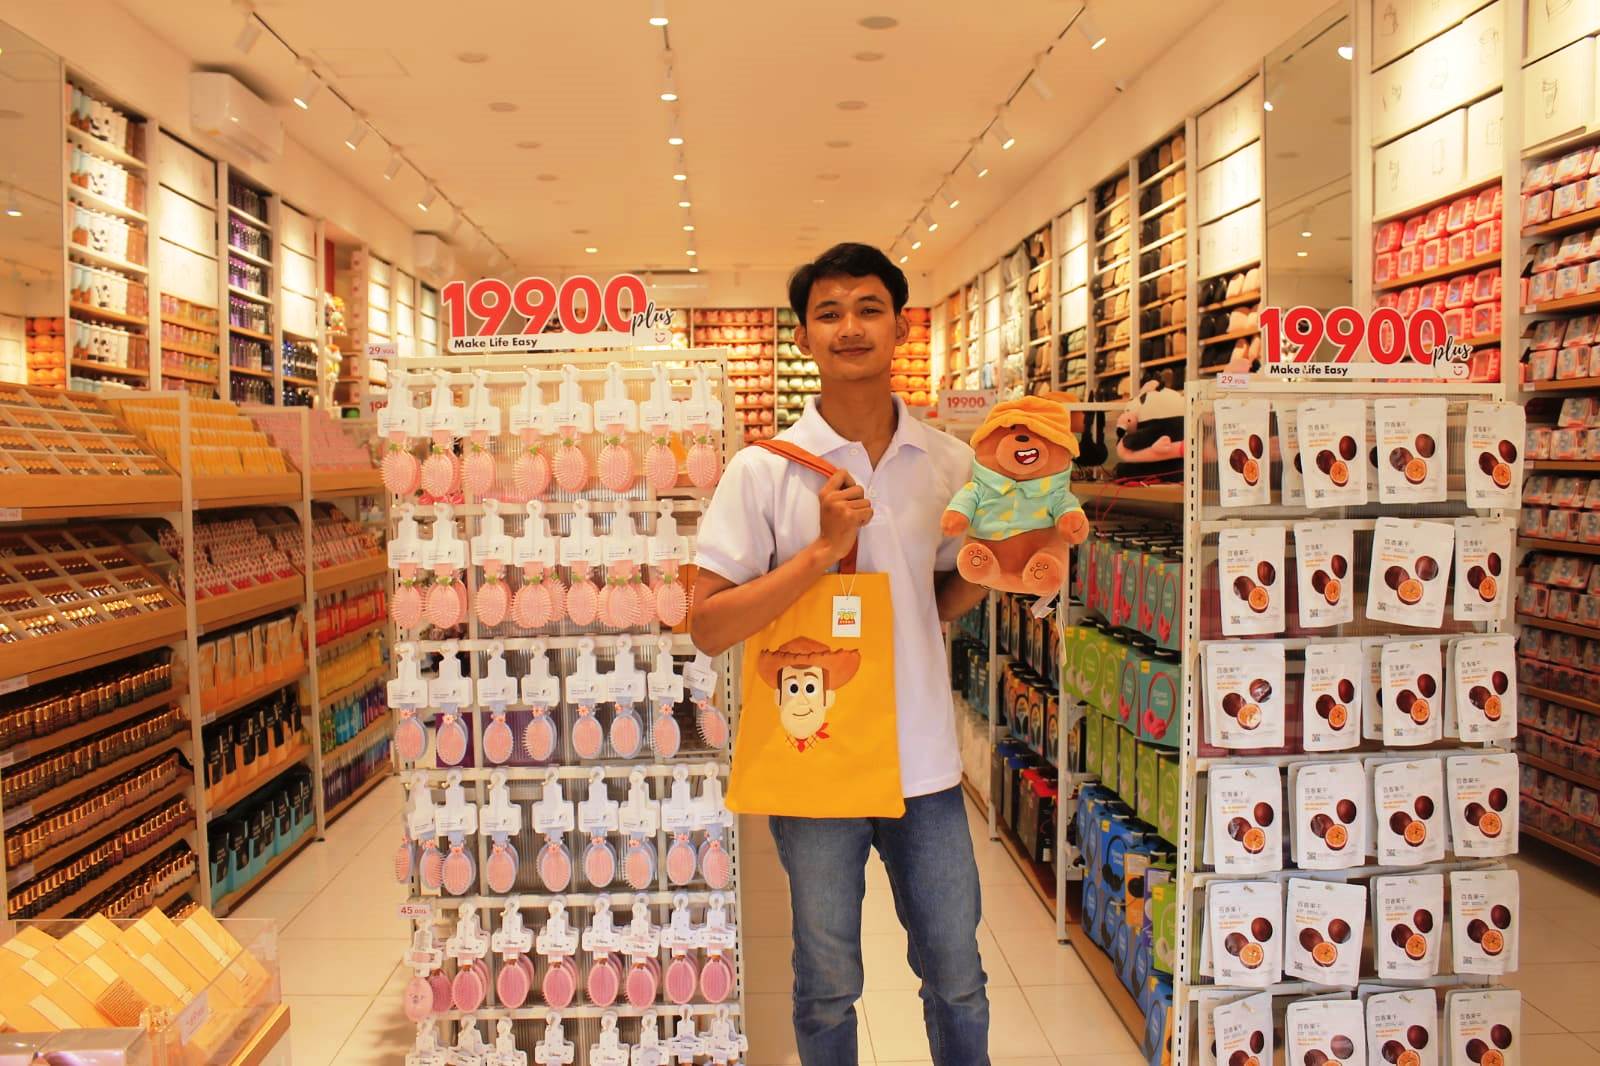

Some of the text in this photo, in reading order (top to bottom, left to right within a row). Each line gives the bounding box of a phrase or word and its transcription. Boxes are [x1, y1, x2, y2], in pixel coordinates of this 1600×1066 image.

[442, 274, 674, 337] 19900 plus
[454, 337, 538, 349] Make Life Easy
[1259, 307, 1473, 367] 19900 plus
[1270, 365, 1300, 375] Make
[1324, 365, 1348, 376] Easy
[1221, 375, 1233, 384] 29
[947, 396, 986, 408] 19900
[401, 906, 413, 915] 45
